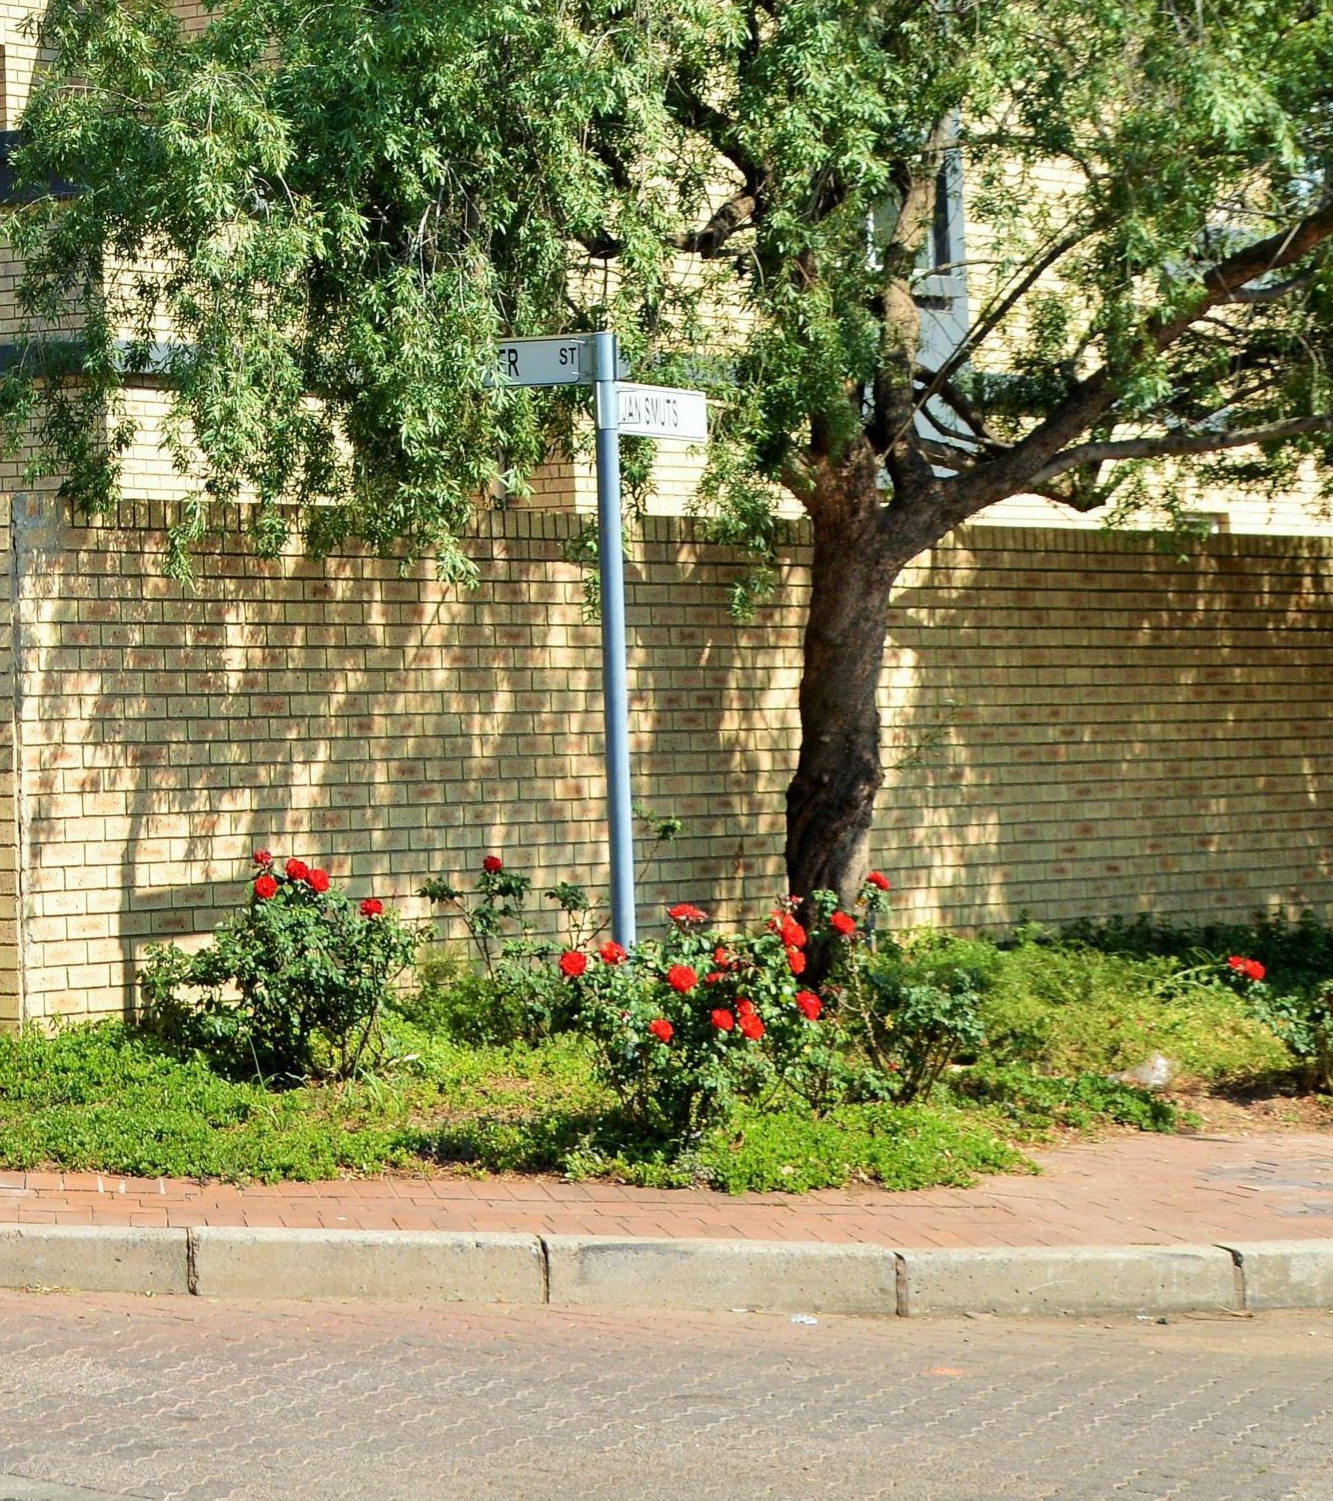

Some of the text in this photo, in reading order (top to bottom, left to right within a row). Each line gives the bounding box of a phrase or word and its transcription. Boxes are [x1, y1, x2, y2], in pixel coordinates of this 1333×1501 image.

[559, 347, 576, 366] ST
[621, 395, 678, 428] JAN SMUTS
